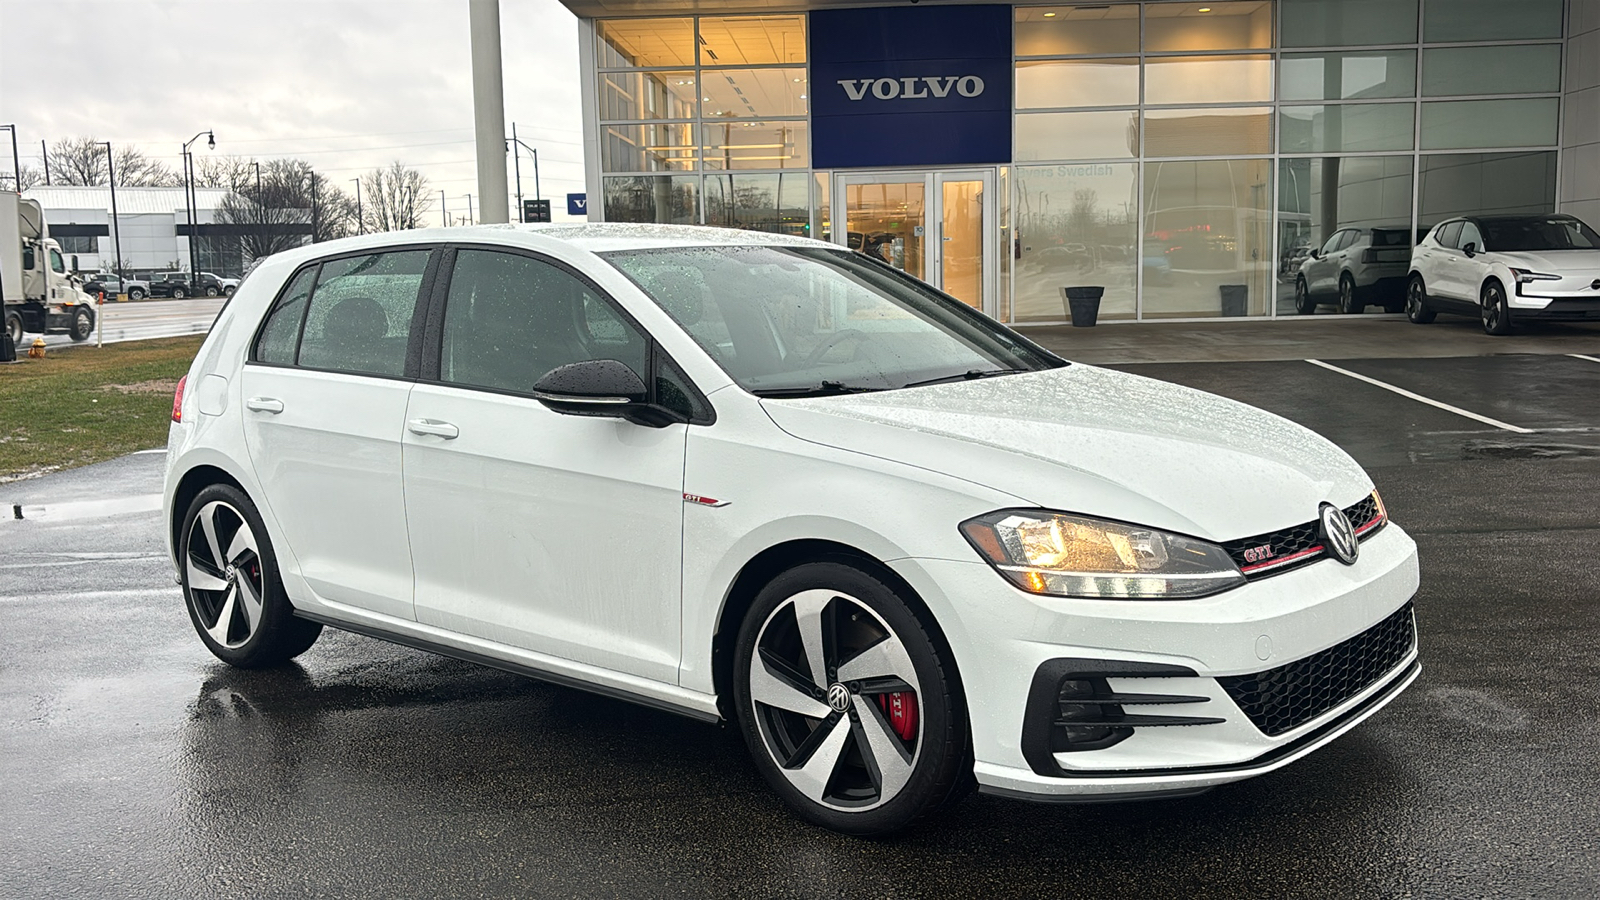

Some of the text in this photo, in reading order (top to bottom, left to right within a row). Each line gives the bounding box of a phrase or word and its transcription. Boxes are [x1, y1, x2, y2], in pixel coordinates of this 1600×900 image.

[837, 75, 985, 101] VOLVO
[1057, 164, 1113, 178] Swedish
[685, 494, 701, 502] GTI
[1243, 544, 1274, 563] GTI
